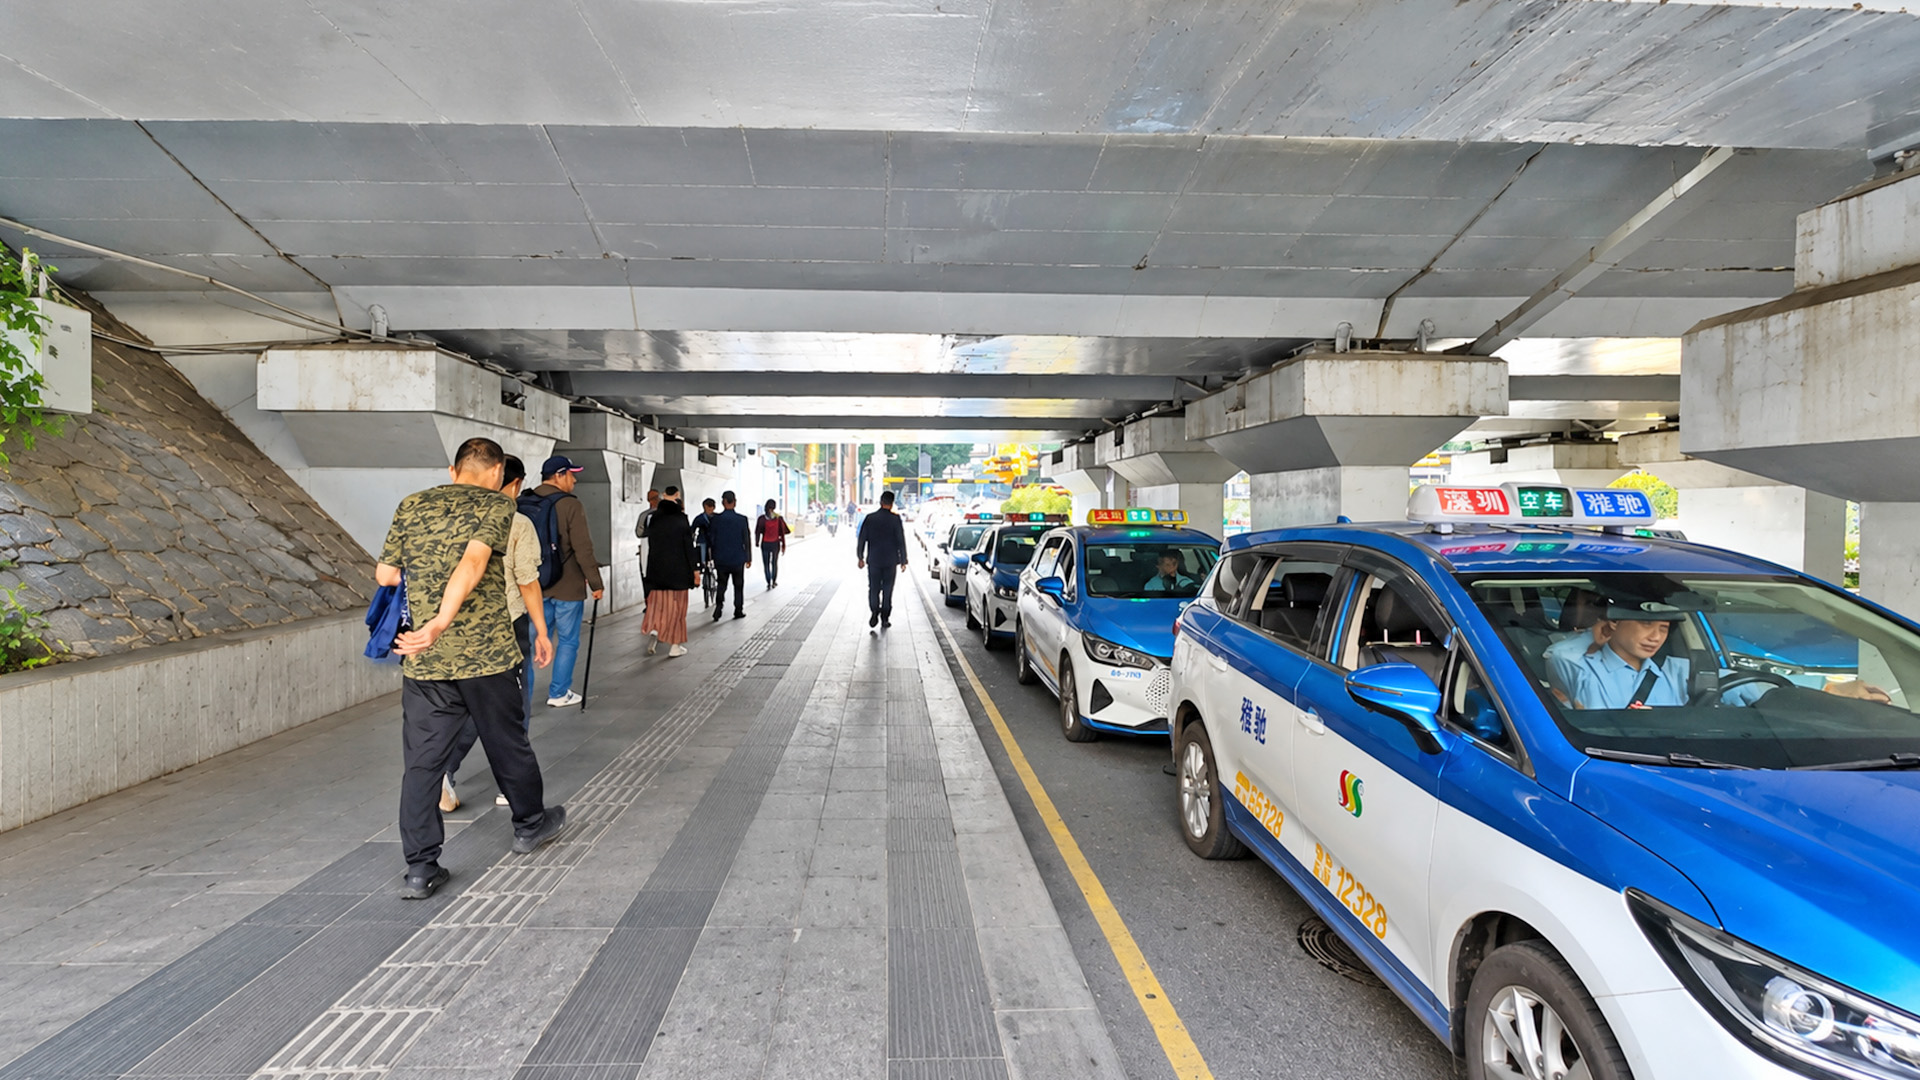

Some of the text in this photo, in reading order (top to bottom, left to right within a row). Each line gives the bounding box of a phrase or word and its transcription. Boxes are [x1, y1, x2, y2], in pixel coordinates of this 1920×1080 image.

[1443, 490, 1646, 515] 深圳 空车 雅驰
[1240, 697, 1267, 745] 雅驰
[1336, 867, 1388, 939] 12328
